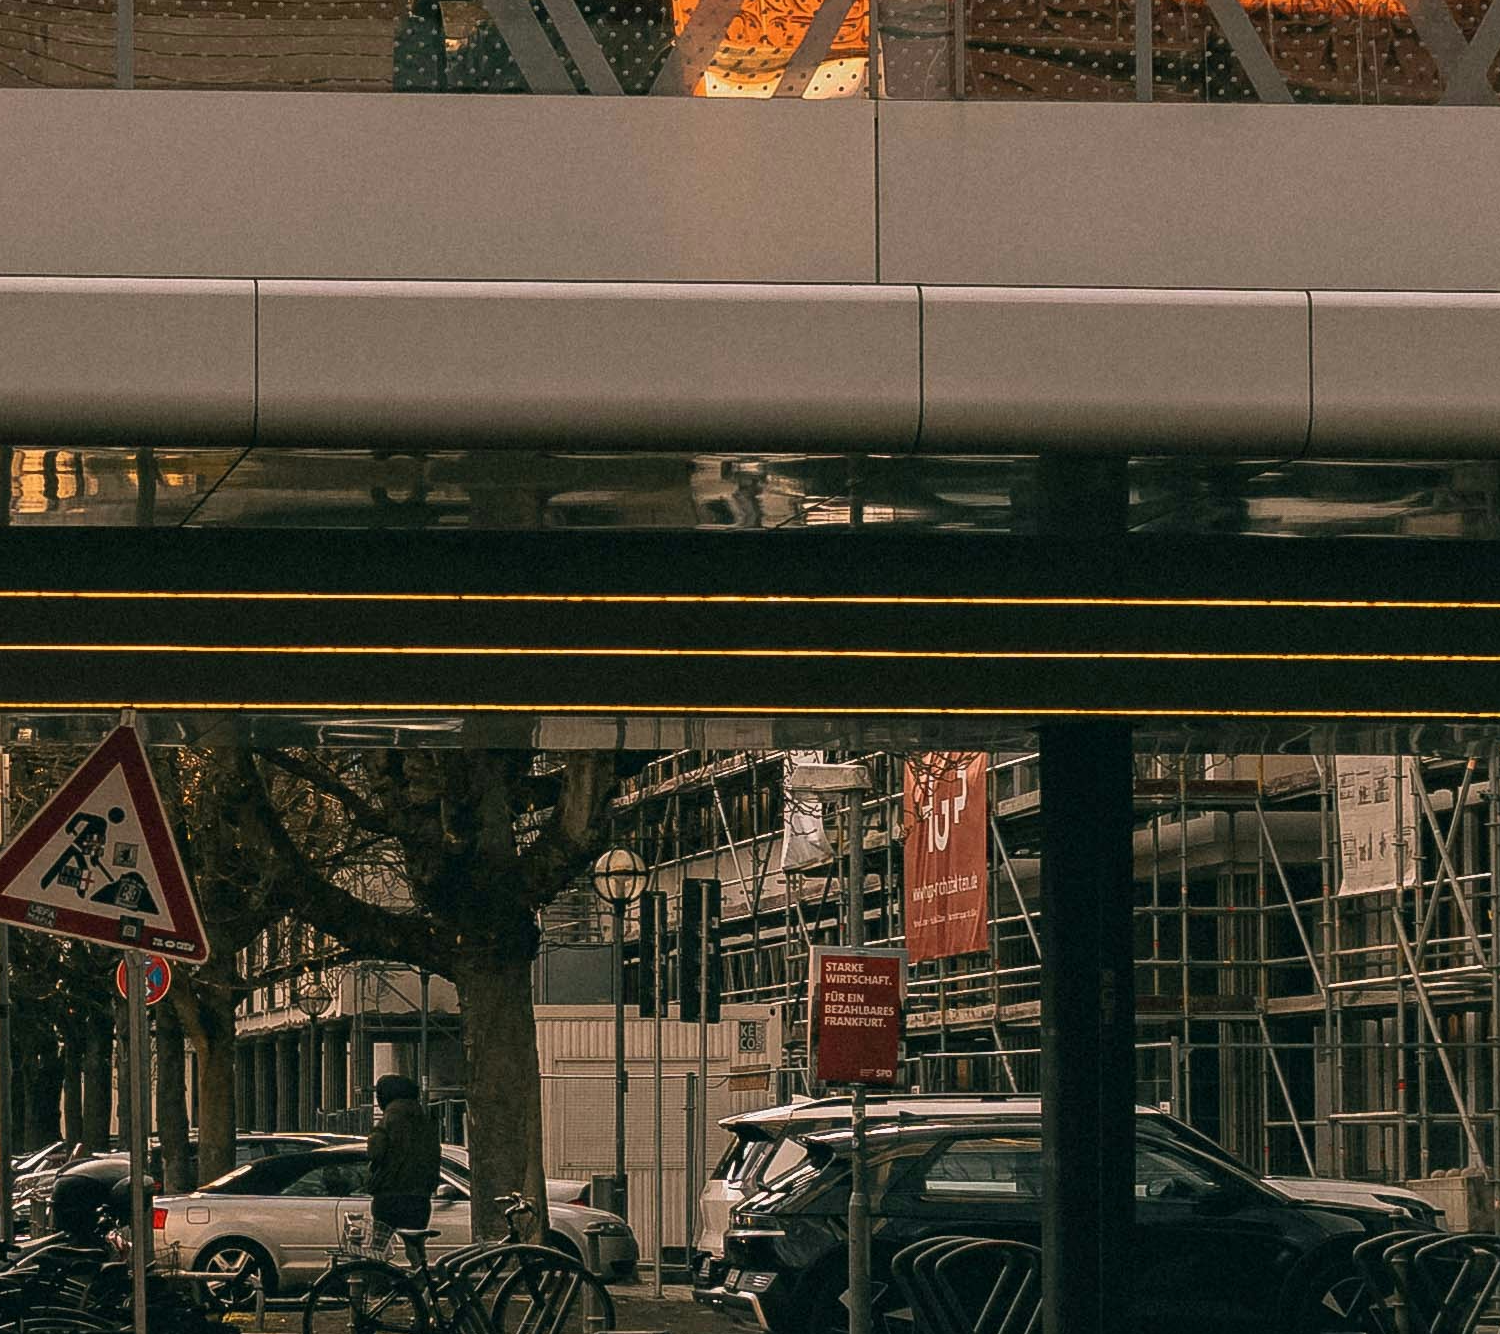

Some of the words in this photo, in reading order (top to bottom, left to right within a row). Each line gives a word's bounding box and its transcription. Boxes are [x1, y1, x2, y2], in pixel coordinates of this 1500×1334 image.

[825, 962, 864, 973] STARKE
[825, 974, 892, 986] WIRTSCHAFT.
[824, 991, 845, 1003] FÜR
[847, 993, 864, 1003] EIN
[824, 1005, 895, 1016] BEZAHLBARES
[824, 1016, 887, 1028] FRANKFURT.
[740, 1037, 755, 1049] CO
[876, 1069, 892, 1078] SPD
